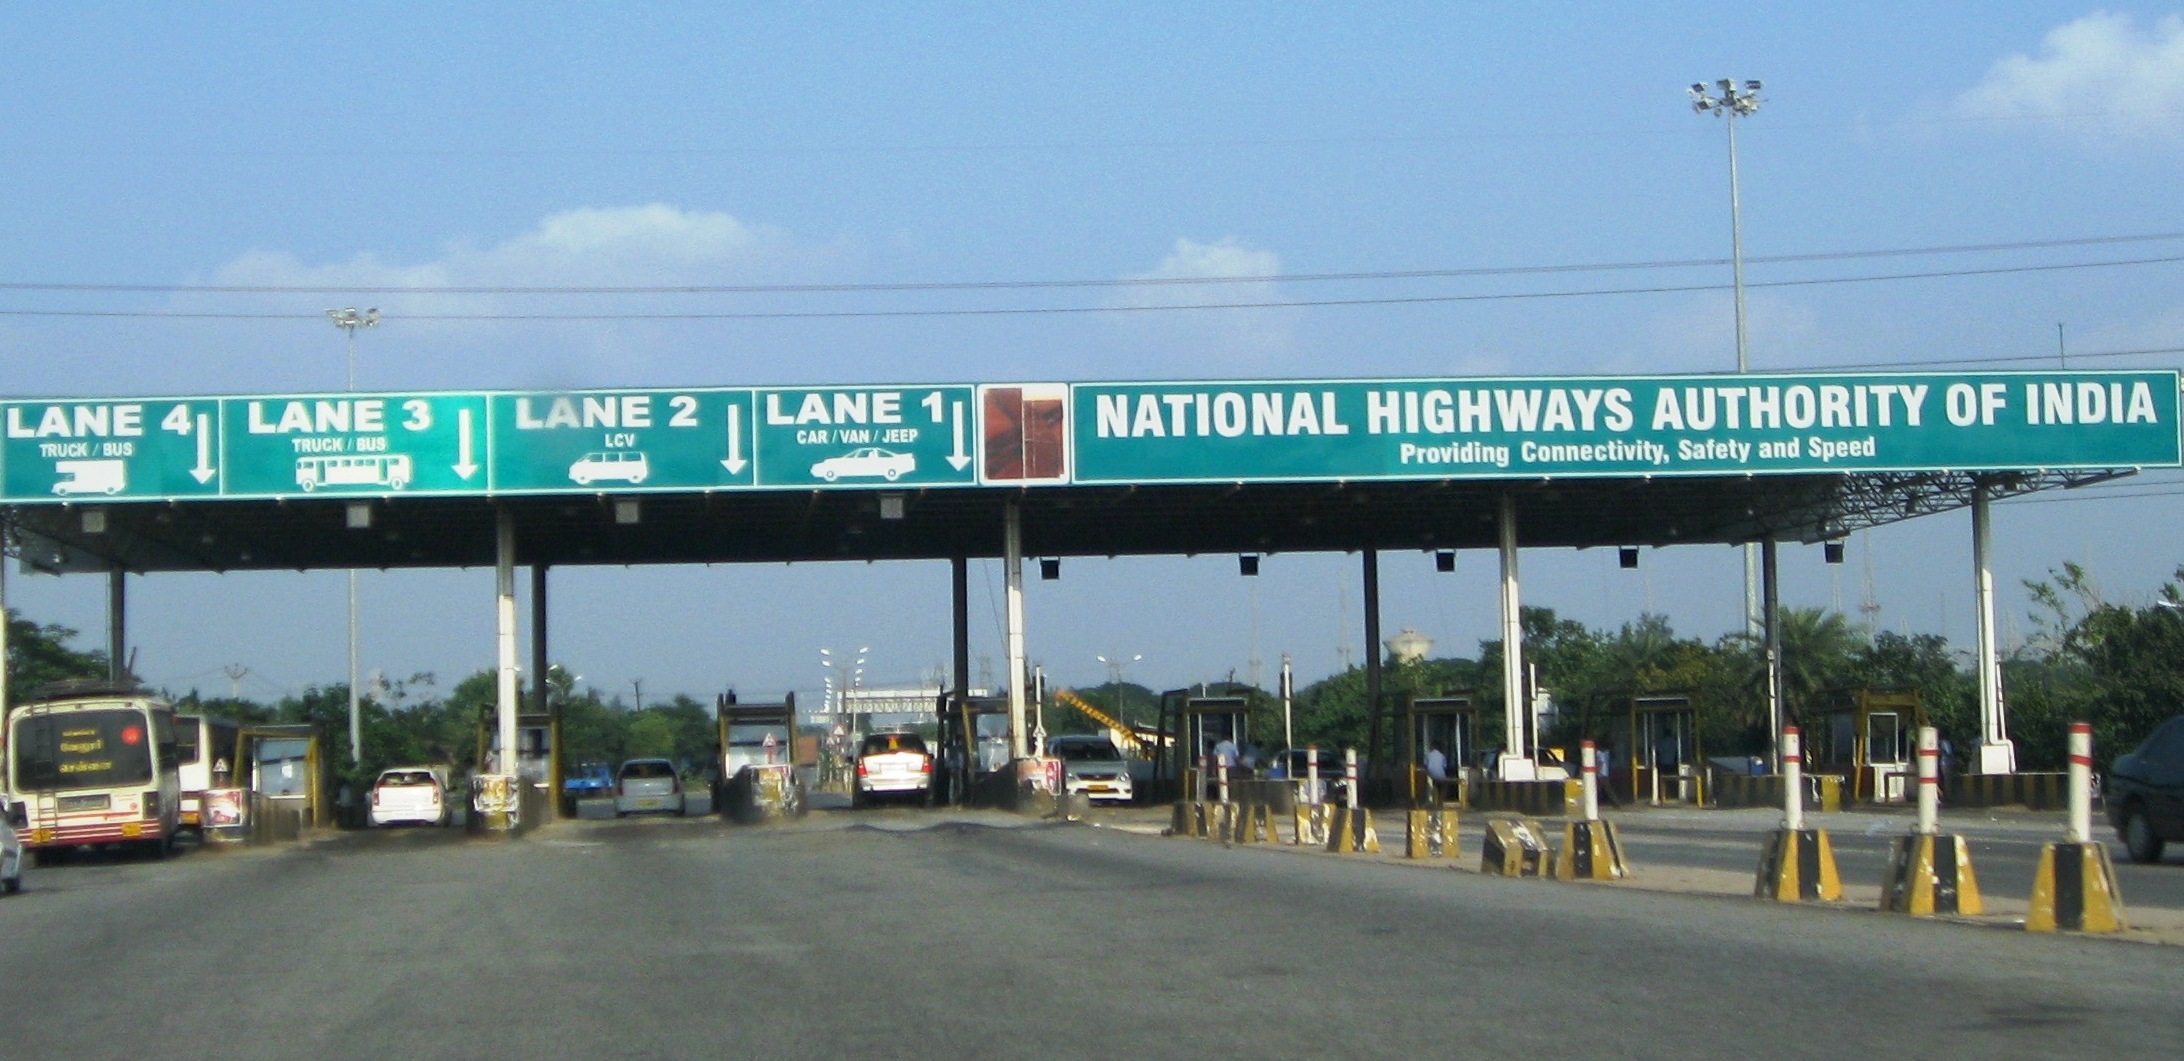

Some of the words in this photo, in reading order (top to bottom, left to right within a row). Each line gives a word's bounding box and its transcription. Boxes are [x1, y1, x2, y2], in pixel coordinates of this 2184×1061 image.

[7, 404, 144, 438] LANE
[161, 404, 192, 436] 4
[248, 401, 385, 434] LANE
[402, 399, 432, 431] 3
[516, 396, 651, 429] LANE
[669, 395, 698, 427] 2
[766, 392, 902, 425] LANE
[921, 391, 944, 422] 1
[1096, 391, 1349, 438] NATIONAL
[1367, 387, 1634, 434] HIGHWAYS
[1652, 384, 1929, 431] AUTHORITY
[1946, 382, 2007, 427] OF
[2026, 381, 2158, 425] INDIA
[39, 443, 88, 458] TRUCK
[103, 442, 133, 457] BUS
[291, 438, 344, 453] TRUCK
[356, 437, 387, 452] BUS
[604, 433, 636, 448] LCV
[796, 429, 828, 445] CAR
[840, 429, 870, 444] VAN
[882, 428, 919, 444] JEEP
[1400, 441, 1510, 468] Providing
[1521, 437, 1670, 465] Connectivity,
[1678, 437, 1750, 463] Safety
[1758, 436, 1800, 459] and
[1808, 435, 1876, 462] Speed
